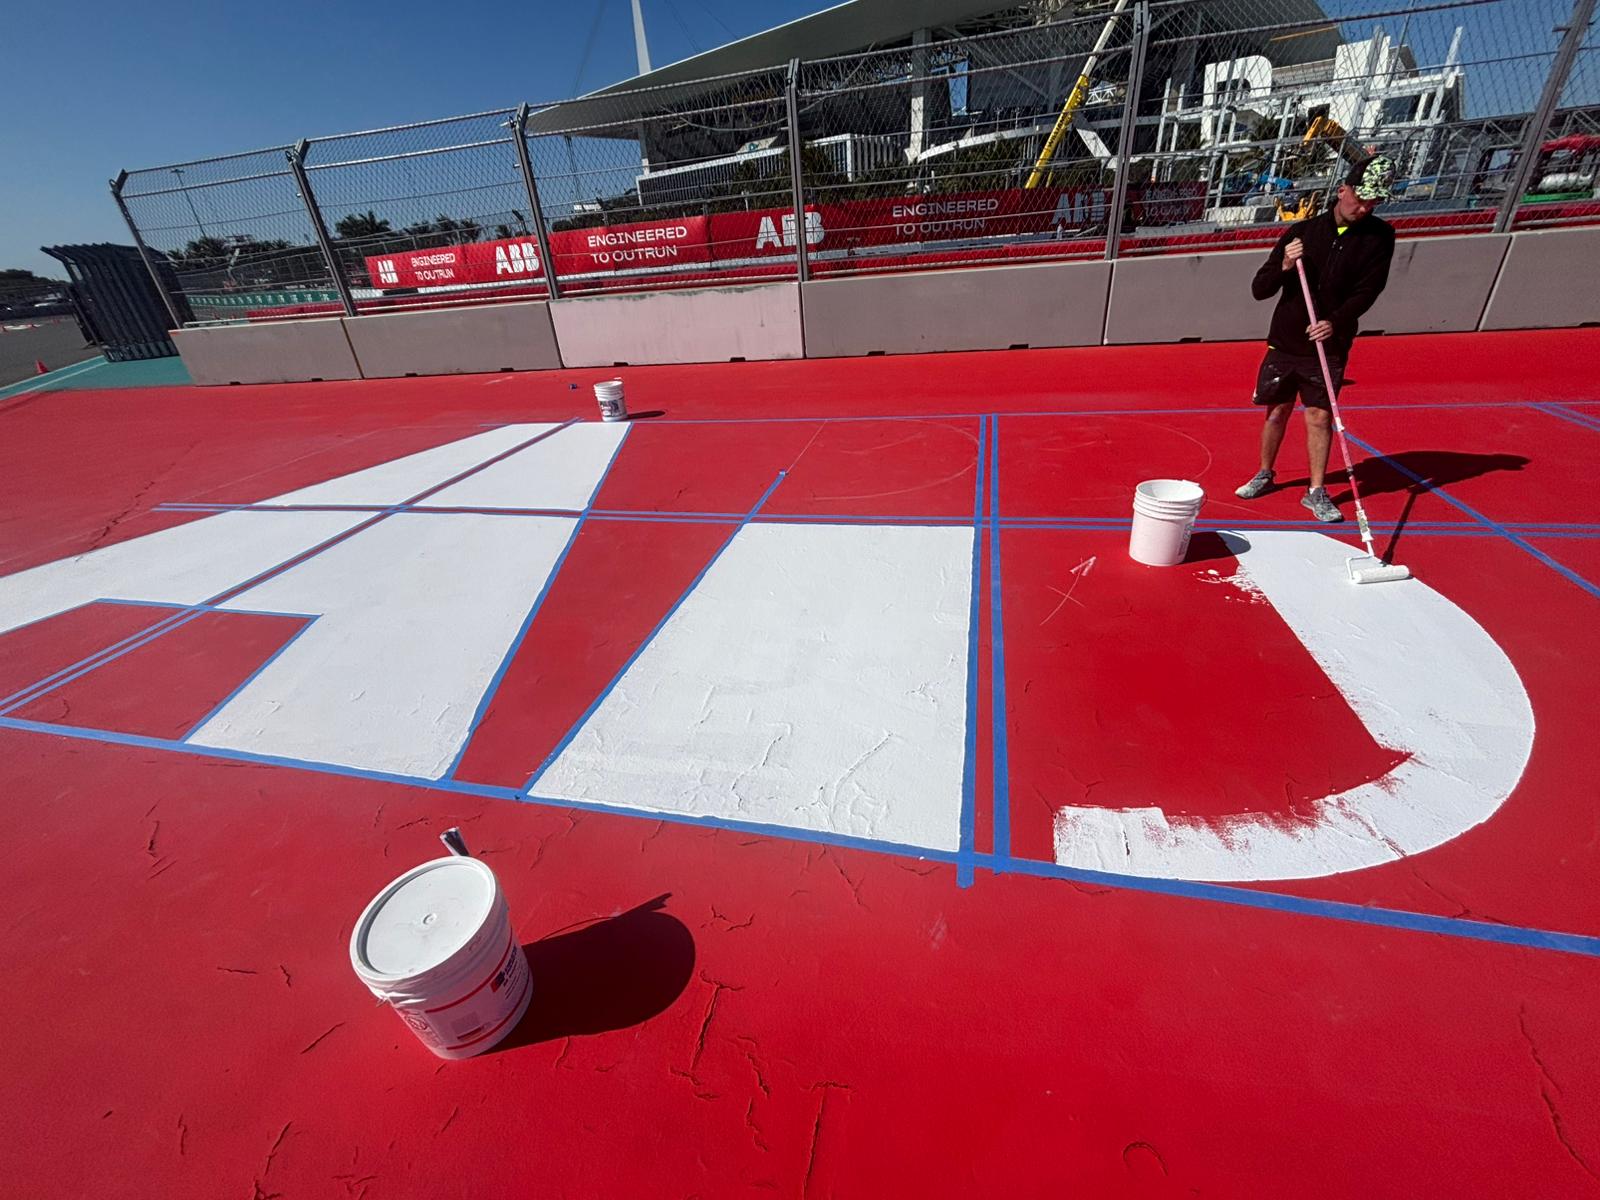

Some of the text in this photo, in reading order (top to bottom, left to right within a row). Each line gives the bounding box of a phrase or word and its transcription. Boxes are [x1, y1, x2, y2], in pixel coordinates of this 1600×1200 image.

[892, 198, 999, 218] ENGINEERED
[894, 218, 985, 236] TO OUTRUN
[587, 226, 687, 248] ENGINEERED
[411, 253, 456, 267] ENGINEERED
[495, 242, 540, 275] ABB
[590, 245, 678, 264] TO OUTRUN
[415, 268, 455, 280] TO OUTRUN
